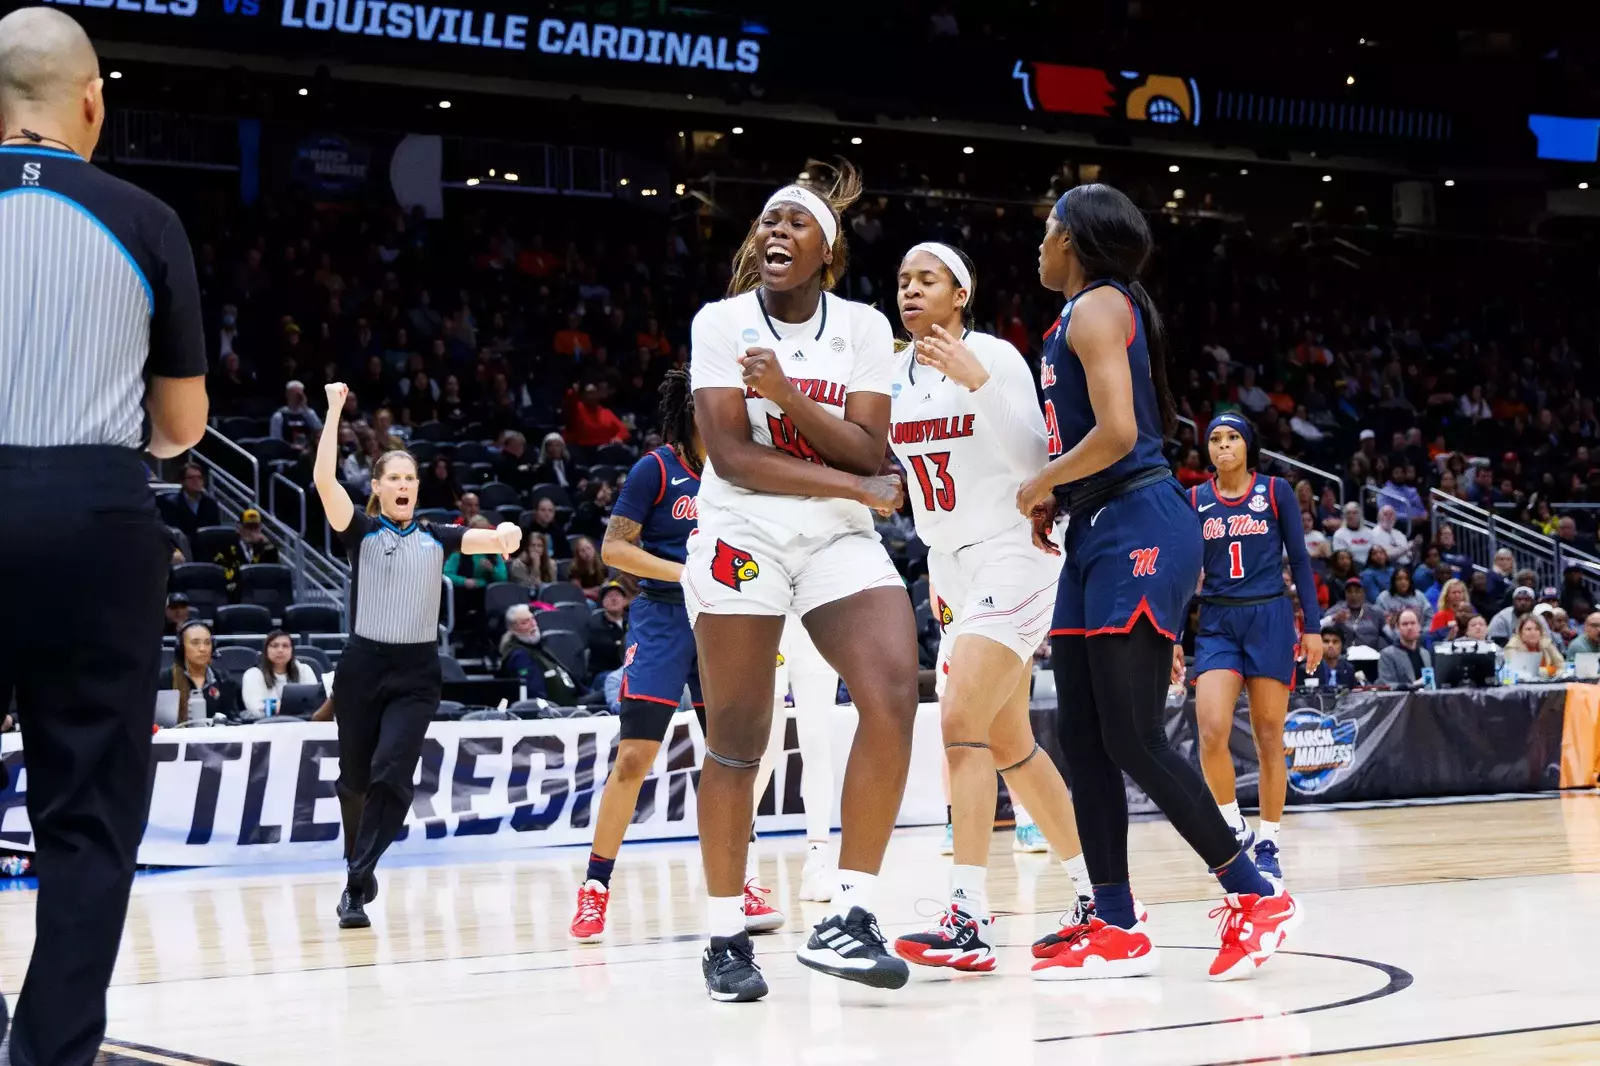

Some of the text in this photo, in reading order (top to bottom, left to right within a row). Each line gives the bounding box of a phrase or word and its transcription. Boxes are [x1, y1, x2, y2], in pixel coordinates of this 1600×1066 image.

[281, 0, 529, 50] LOUISVILLE
[537, 18, 761, 73] CARDINALS
[889, 413, 975, 444] LOUISVILLE
[907, 451, 956, 512] 13
[1203, 513, 1268, 540] Ole Miss
[1228, 541, 1245, 578] 1
[1283, 728, 1335, 749] MARCH
[1293, 743, 1354, 768] MADNESS
